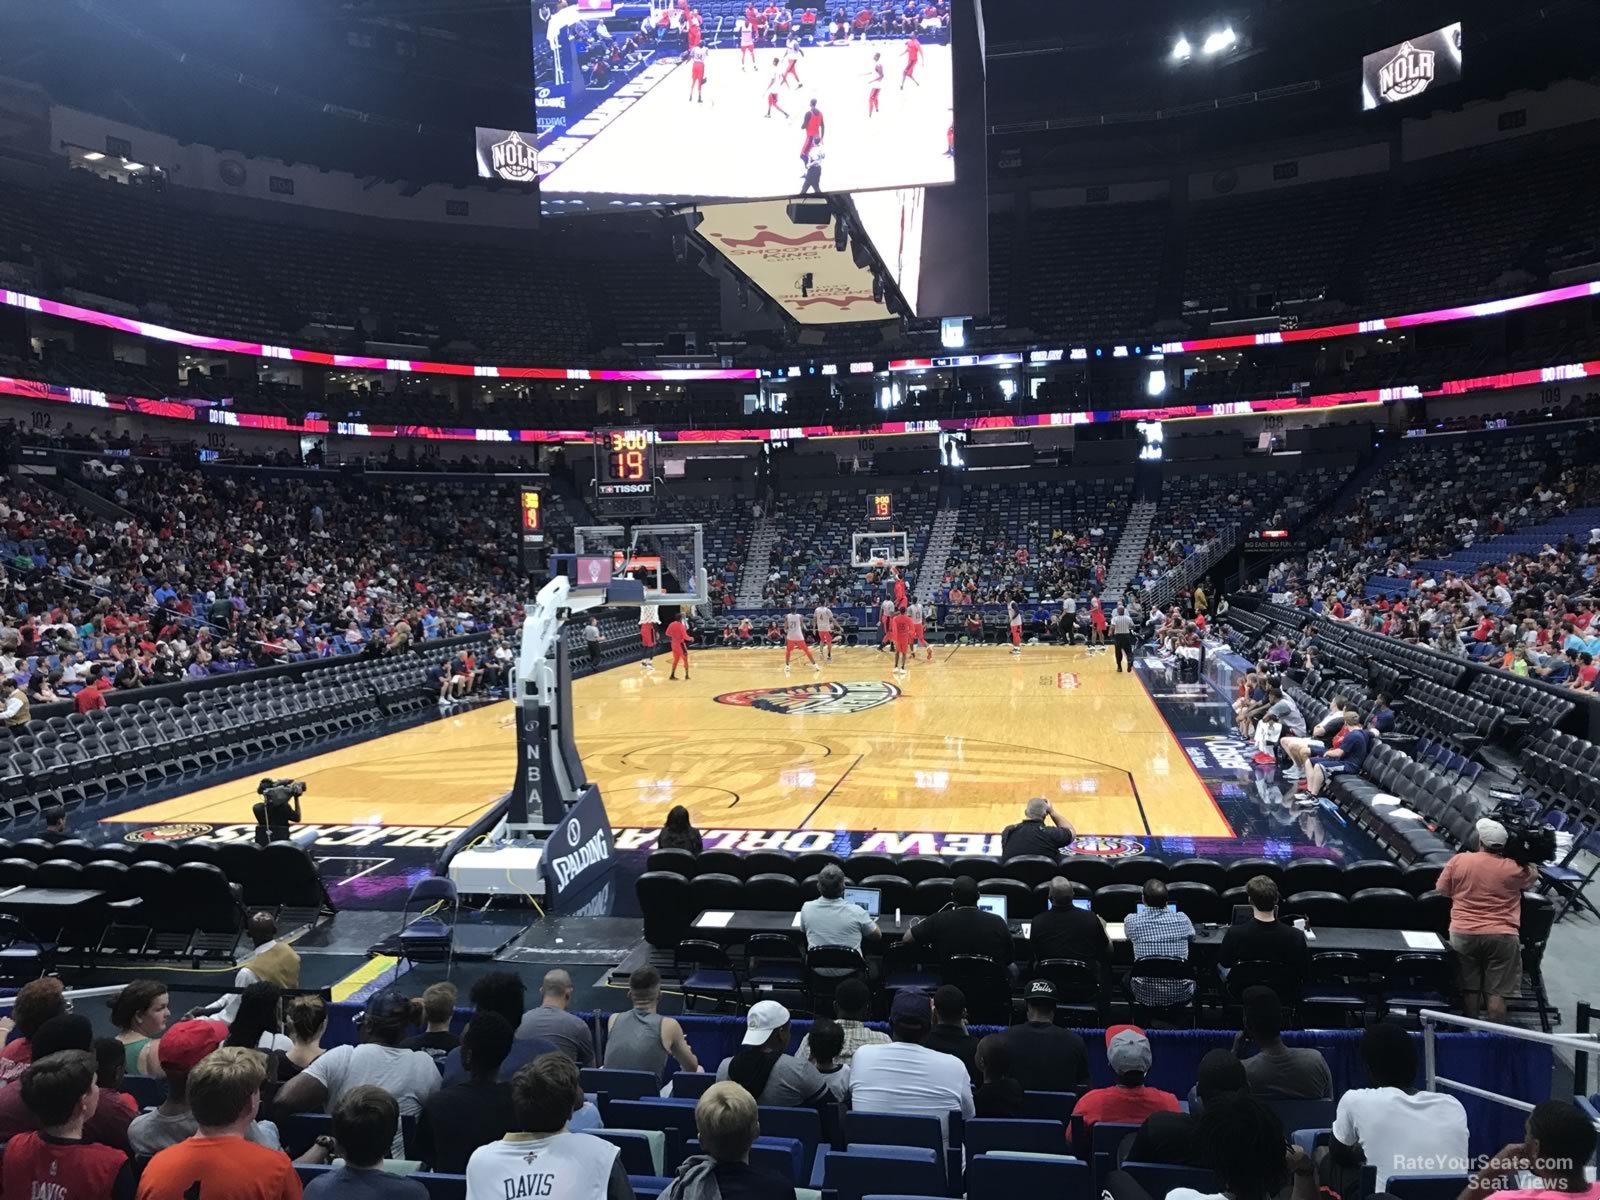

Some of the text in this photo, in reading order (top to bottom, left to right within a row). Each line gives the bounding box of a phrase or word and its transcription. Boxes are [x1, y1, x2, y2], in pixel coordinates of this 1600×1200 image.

[1383, 53, 1432, 92] NOLA
[494, 143, 538, 174] NOLA
[730, 244, 836, 256] SMOOTHI
[32, 411, 51, 428] 102
[207, 433, 225, 448] 103
[613, 434, 647, 451] 3:00
[858, 439, 875, 450] 106
[618, 452, 643, 479] 19
[614, 484, 651, 493] TISSOT
[876, 504, 888, 515] 19
[526, 744, 542, 804] NBA
[551, 828, 610, 894] SPALDING
[1031, 981, 1053, 993] Bulls
[31, 1181, 68, 1200] DAVIS
[503, 1173, 555, 1200] DAVIS
